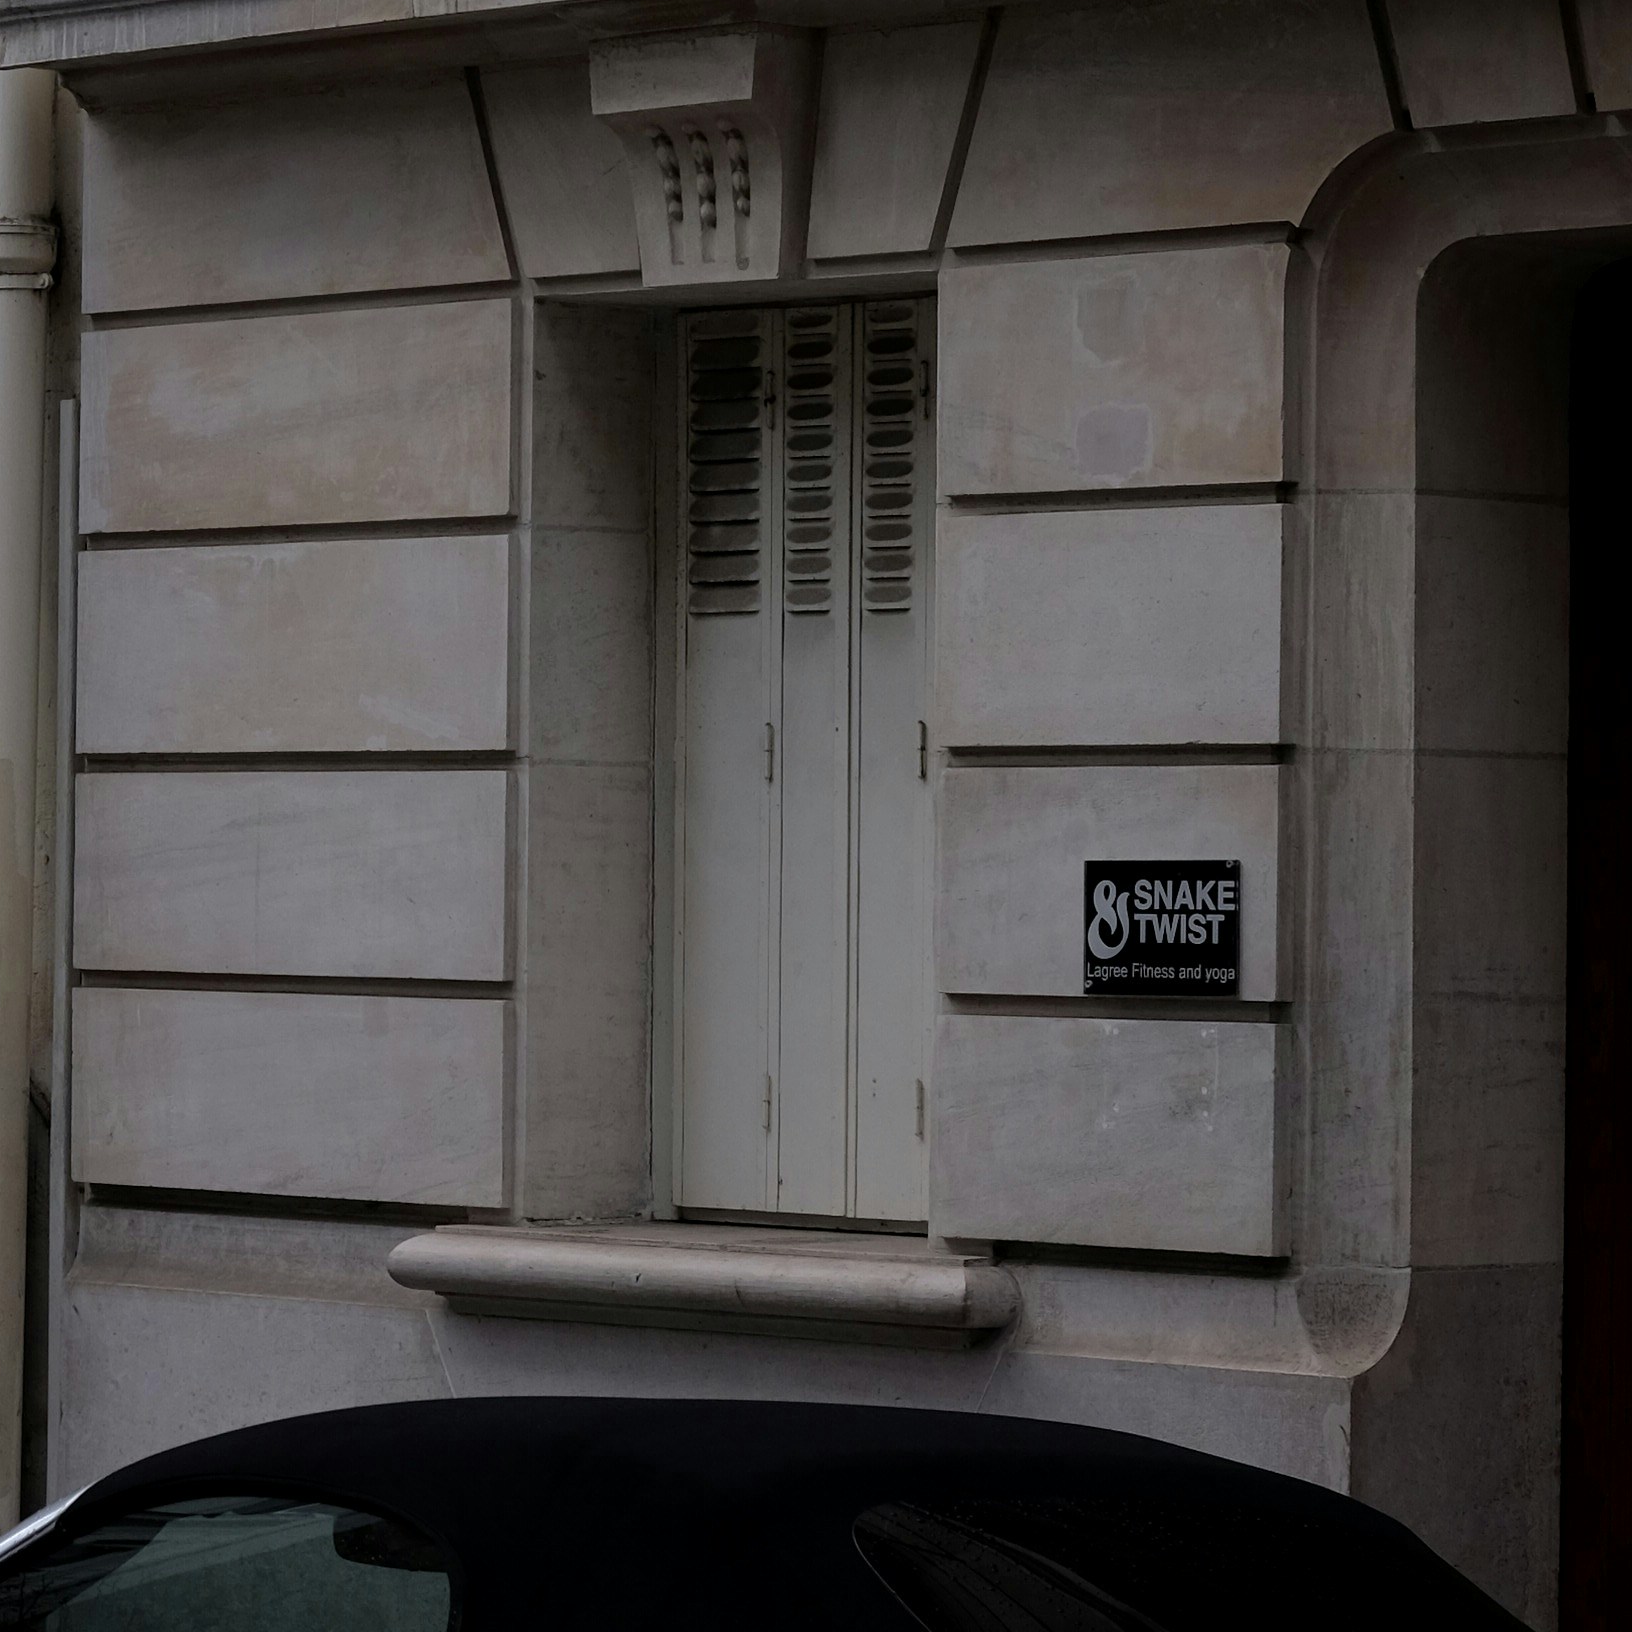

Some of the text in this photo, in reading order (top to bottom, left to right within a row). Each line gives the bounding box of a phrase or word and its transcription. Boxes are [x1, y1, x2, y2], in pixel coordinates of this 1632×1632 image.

[1133, 878, 1237, 911] SNAKE
[1133, 913, 1226, 945] TWIST
[1086, 962, 1236, 984] Lagree Fitness and yoga
